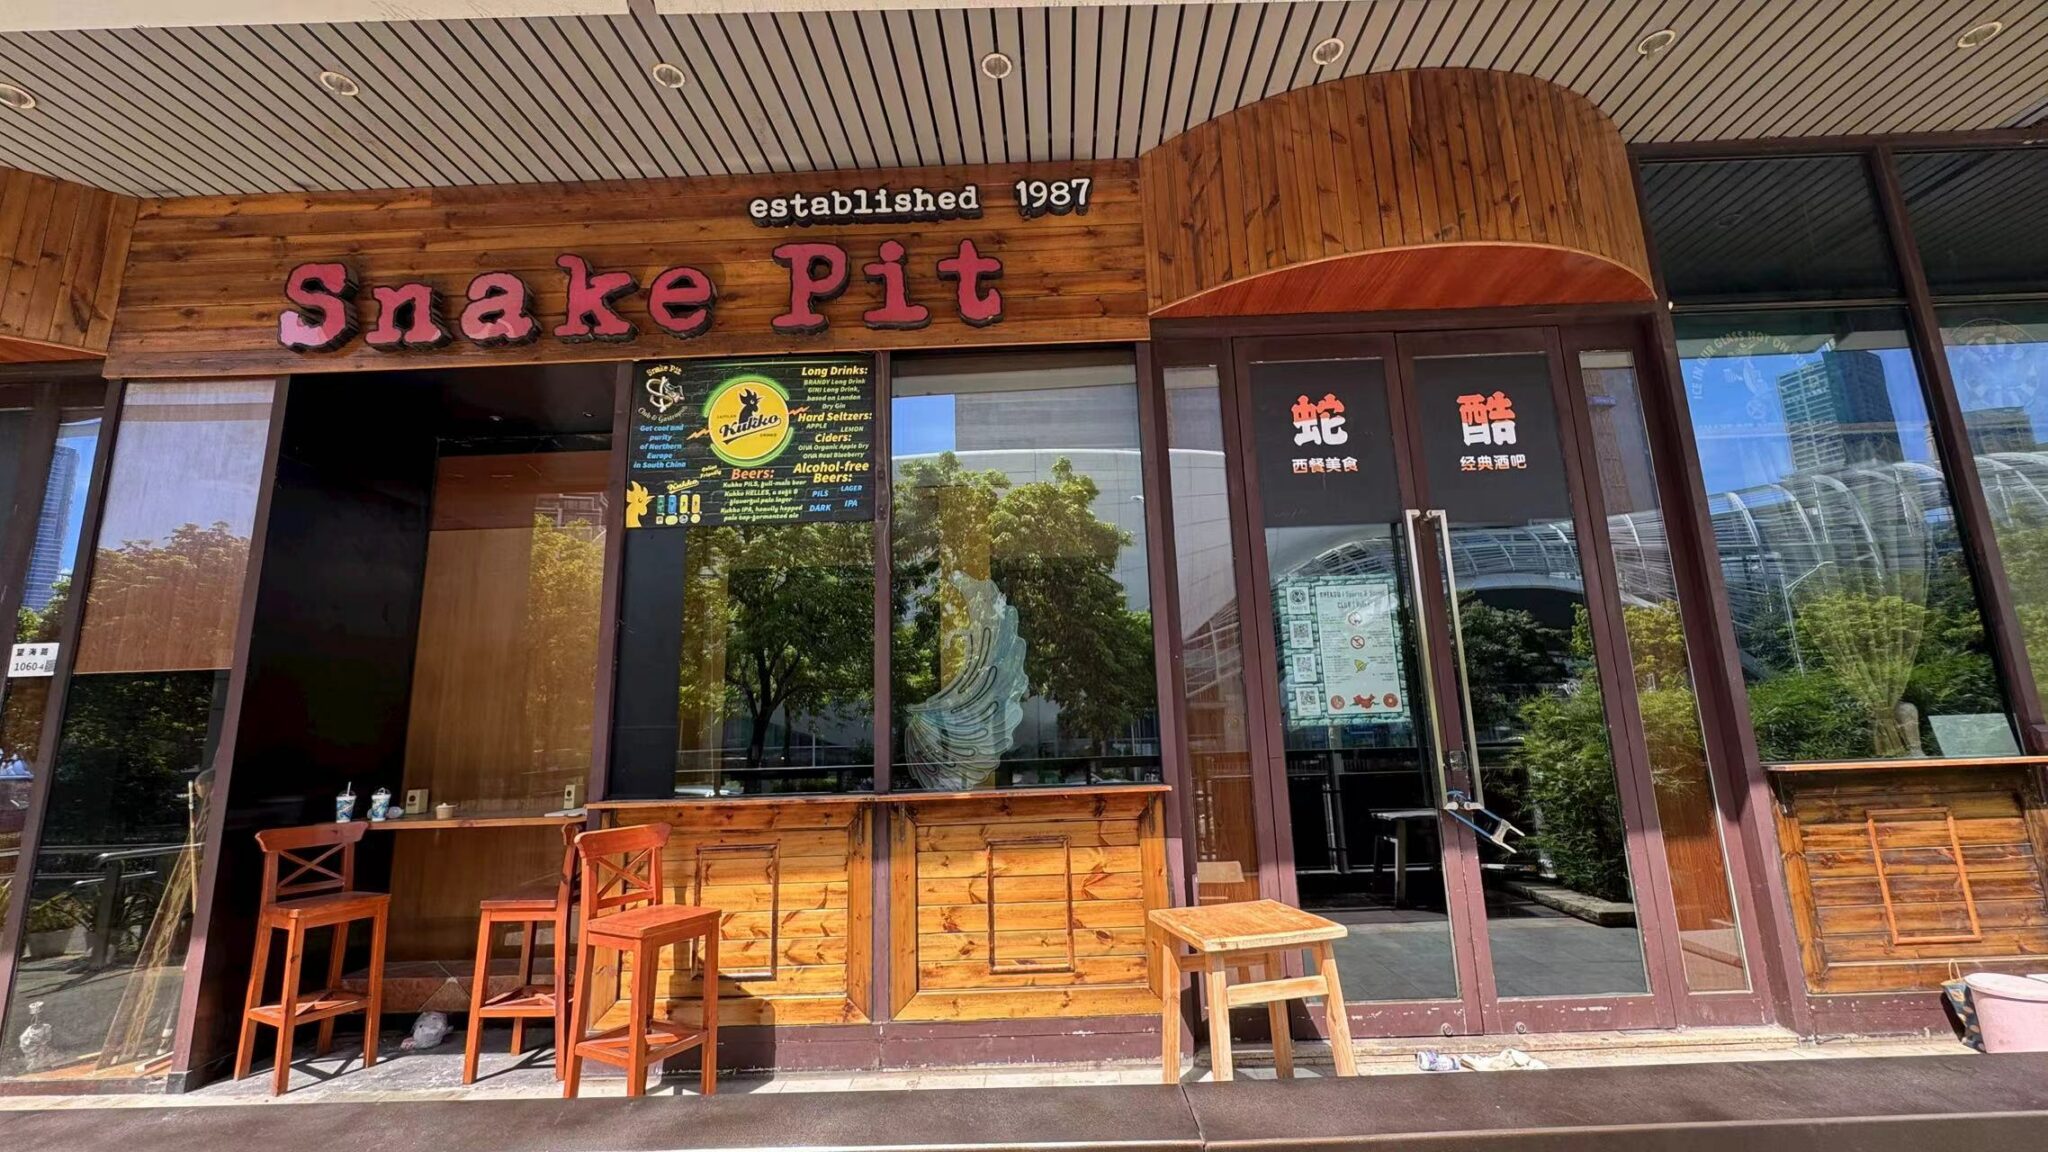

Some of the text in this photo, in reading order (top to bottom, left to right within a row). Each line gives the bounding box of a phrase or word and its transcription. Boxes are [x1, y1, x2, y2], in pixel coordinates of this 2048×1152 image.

[749, 178, 1092, 223] established 1987
[277, 239, 1004, 350] Snake Pit
[646, 364, 682, 377] Snake Pit
[801, 365, 868, 377] Long Drinks:
[797, 412, 873, 422] Hard Seltzers:
[1291, 393, 1348, 446] 蛇
[1456, 391, 1518, 446] 酷
[719, 414, 780, 439] Kukko
[815, 433, 852, 443] Ciders:
[792, 460, 870, 474] Alcohol-free
[1291, 456, 1359, 474] 西餐美食
[1460, 453, 1528, 472] 经典酒吧
[731, 468, 775, 480] Beers:
[813, 473, 853, 483] Beers:
[809, 504, 832, 512] DARK
[15, 648, 49, 656] 望海路
